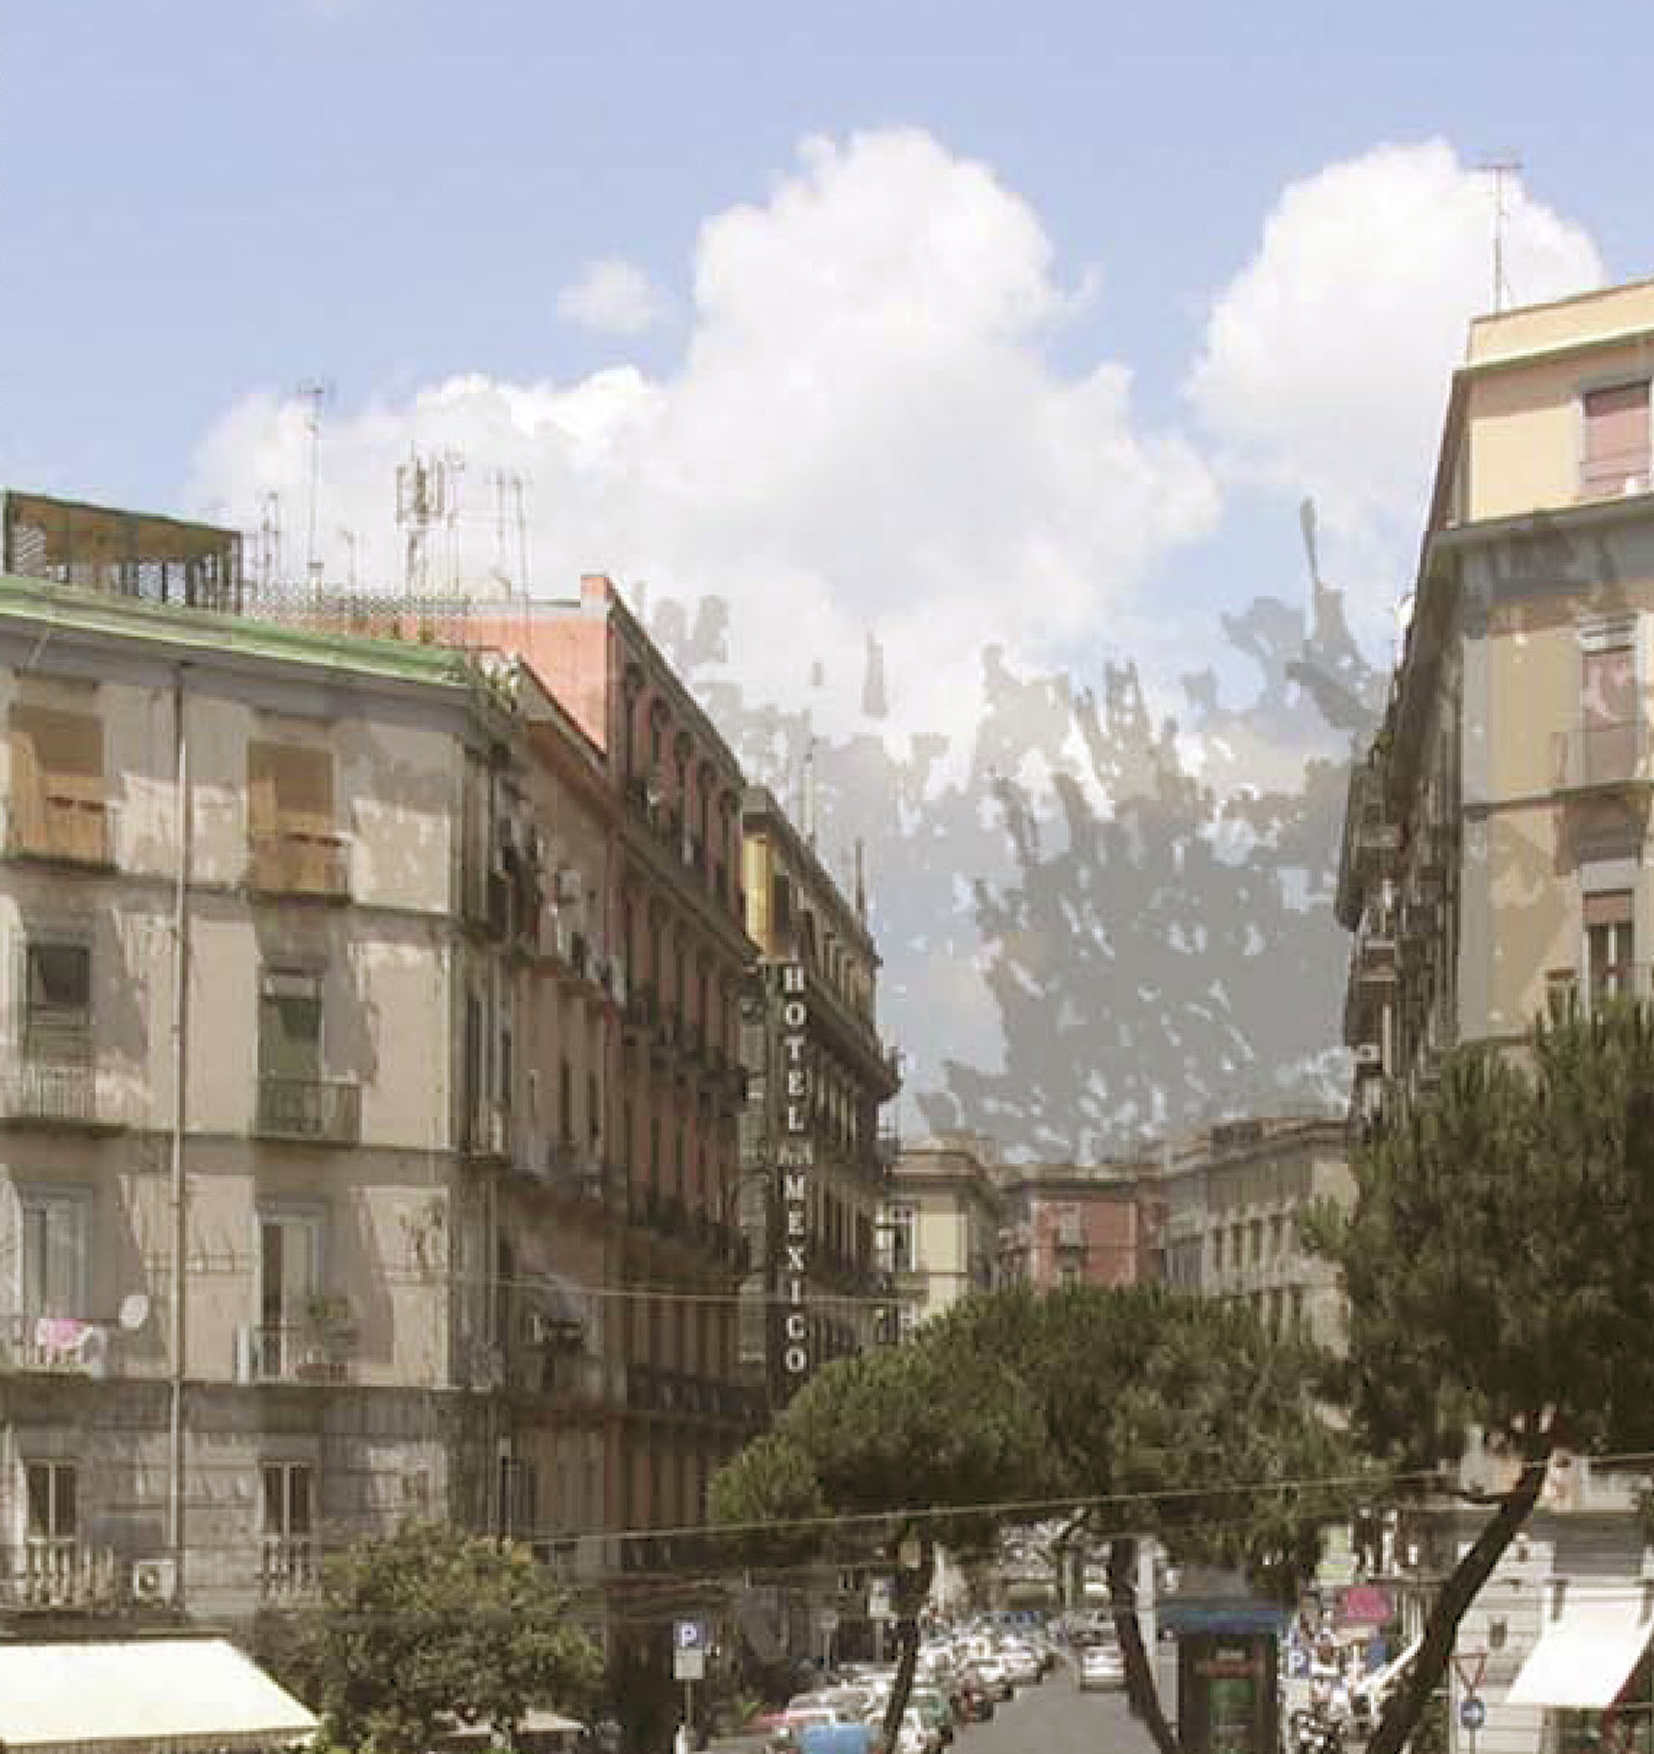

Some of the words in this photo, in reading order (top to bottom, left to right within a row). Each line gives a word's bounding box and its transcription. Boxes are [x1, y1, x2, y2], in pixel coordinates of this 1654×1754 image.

[784, 965, 806, 1134] HOTEL
[784, 1173, 806, 1375] MEXICO
[681, 1622, 697, 1648] P
